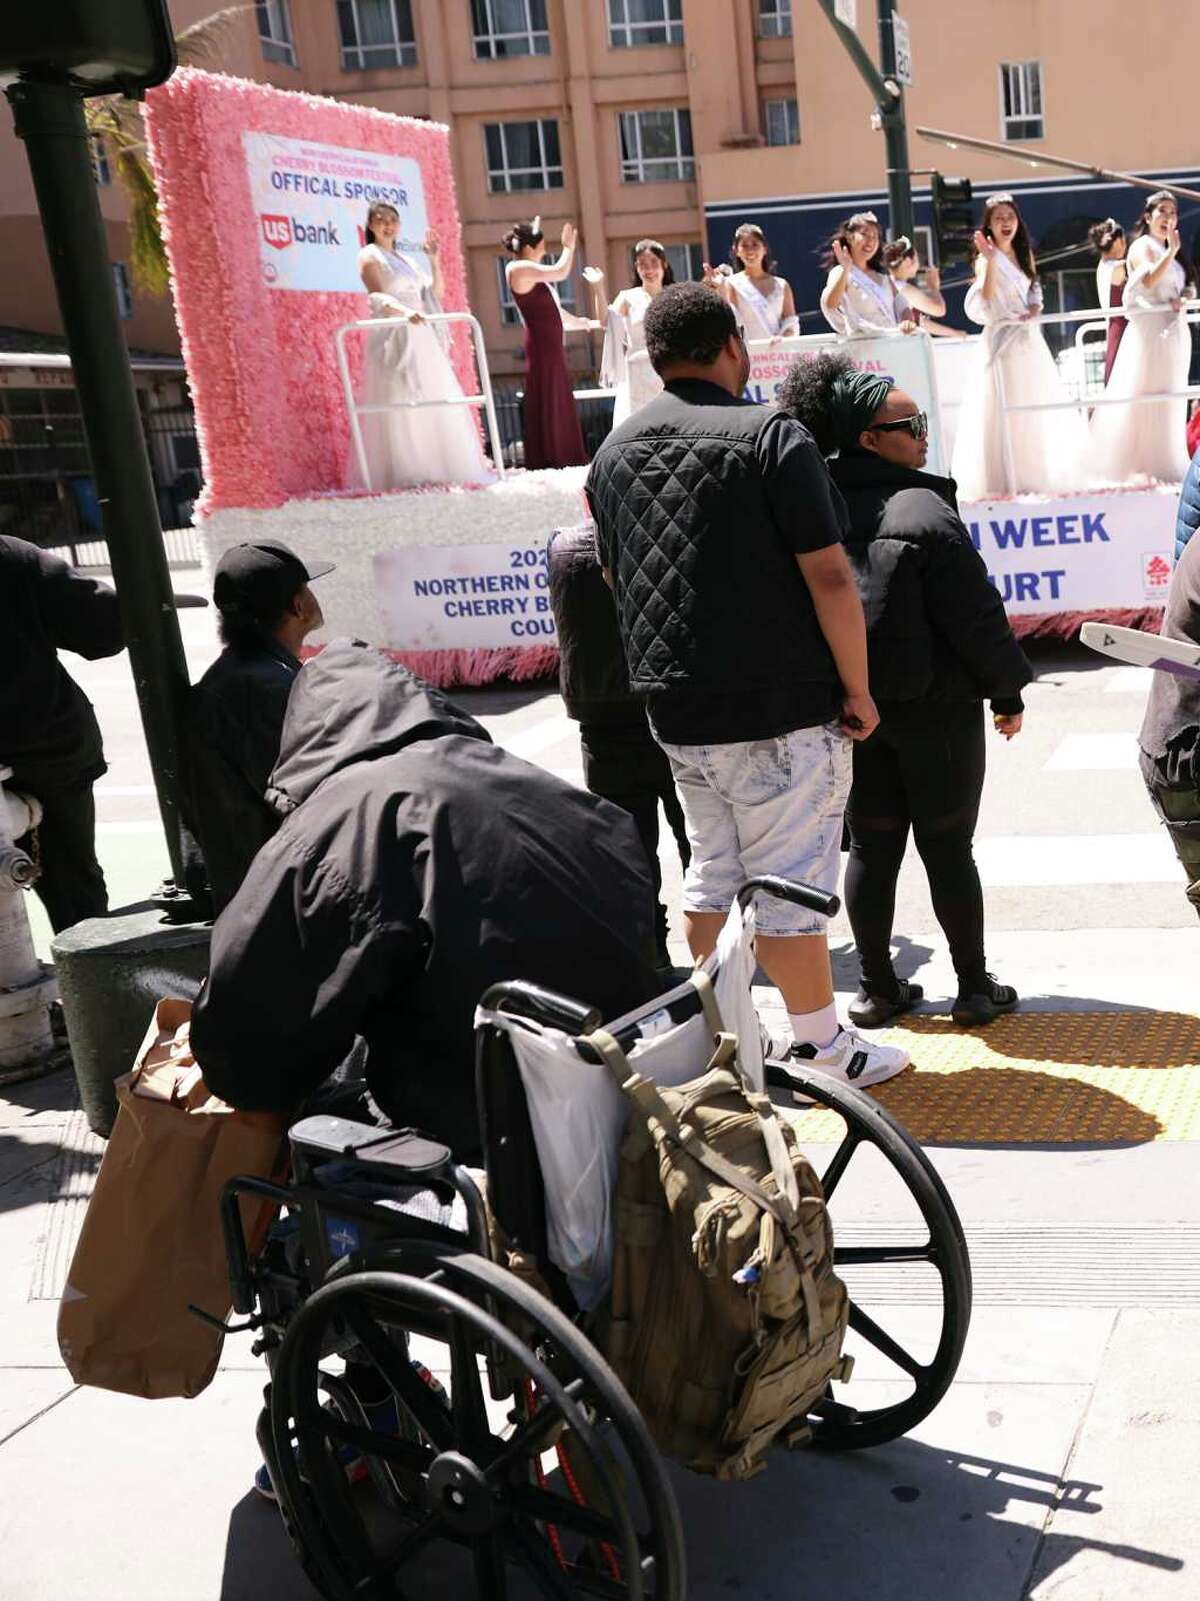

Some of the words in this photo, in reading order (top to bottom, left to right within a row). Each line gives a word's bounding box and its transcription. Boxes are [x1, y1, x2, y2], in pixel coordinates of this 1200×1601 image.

[344, 182, 409, 207] SPONSOR
[292, 216, 341, 246] bank
[990, 512, 1111, 549] WEEK
[413, 573, 530, 597] NORTHERN
[444, 598, 528, 618] CHERRY
